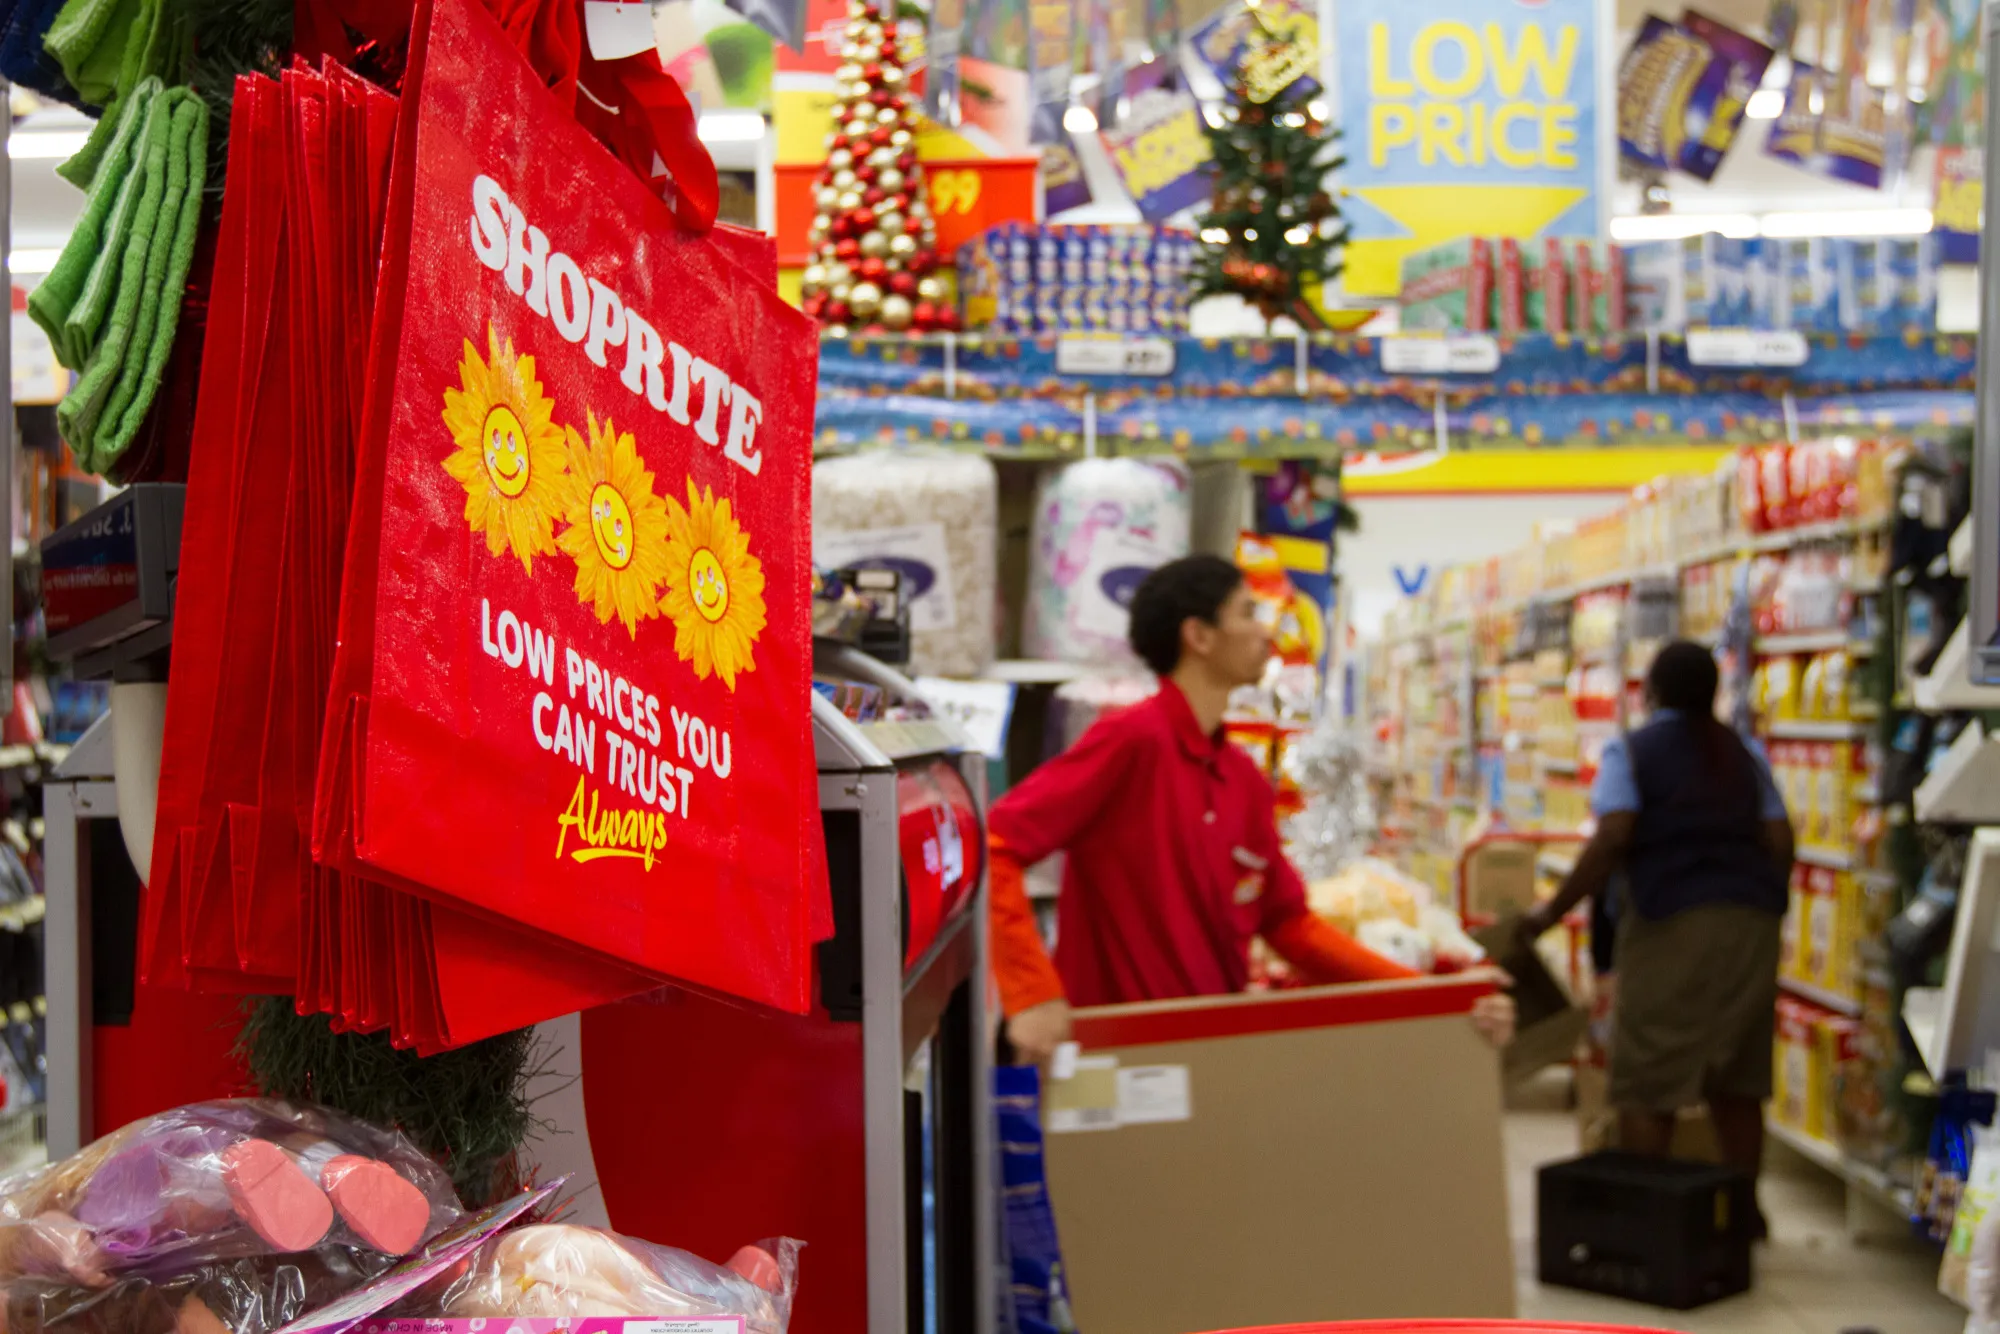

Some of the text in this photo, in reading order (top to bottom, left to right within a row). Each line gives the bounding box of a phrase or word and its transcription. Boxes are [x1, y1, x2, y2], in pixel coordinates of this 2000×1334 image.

[1371, 20, 1579, 98] LOW
[1370, 101, 1578, 169] PRICE
[471, 174, 762, 476] SHOPRITE
[482, 598, 731, 778] LOW PRICES YOU
[532, 692, 693, 819] CAN TRUST
[556, 774, 667, 872] Always
[381, 1324, 453, 1332] MADE IN CHINA
